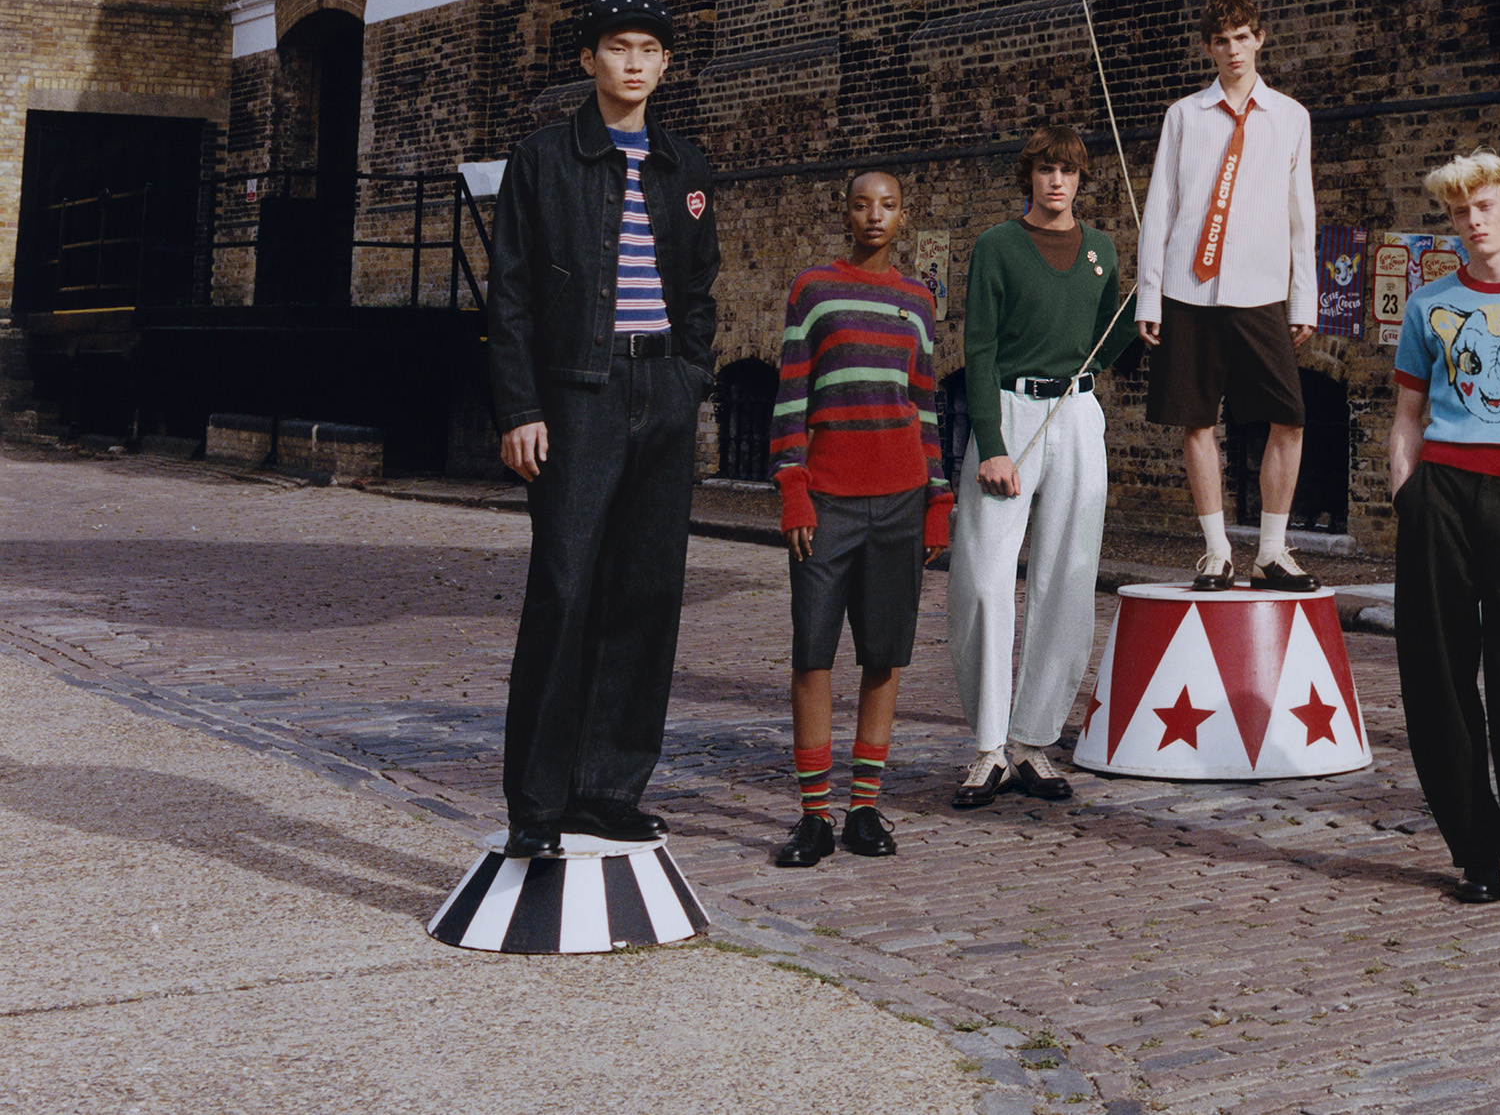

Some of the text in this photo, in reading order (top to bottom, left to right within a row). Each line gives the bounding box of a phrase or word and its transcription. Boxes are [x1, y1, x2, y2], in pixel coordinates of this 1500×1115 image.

[1202, 154, 1238, 266] CIRCUS SCHOOL
[1382, 293, 1399, 315] 23
